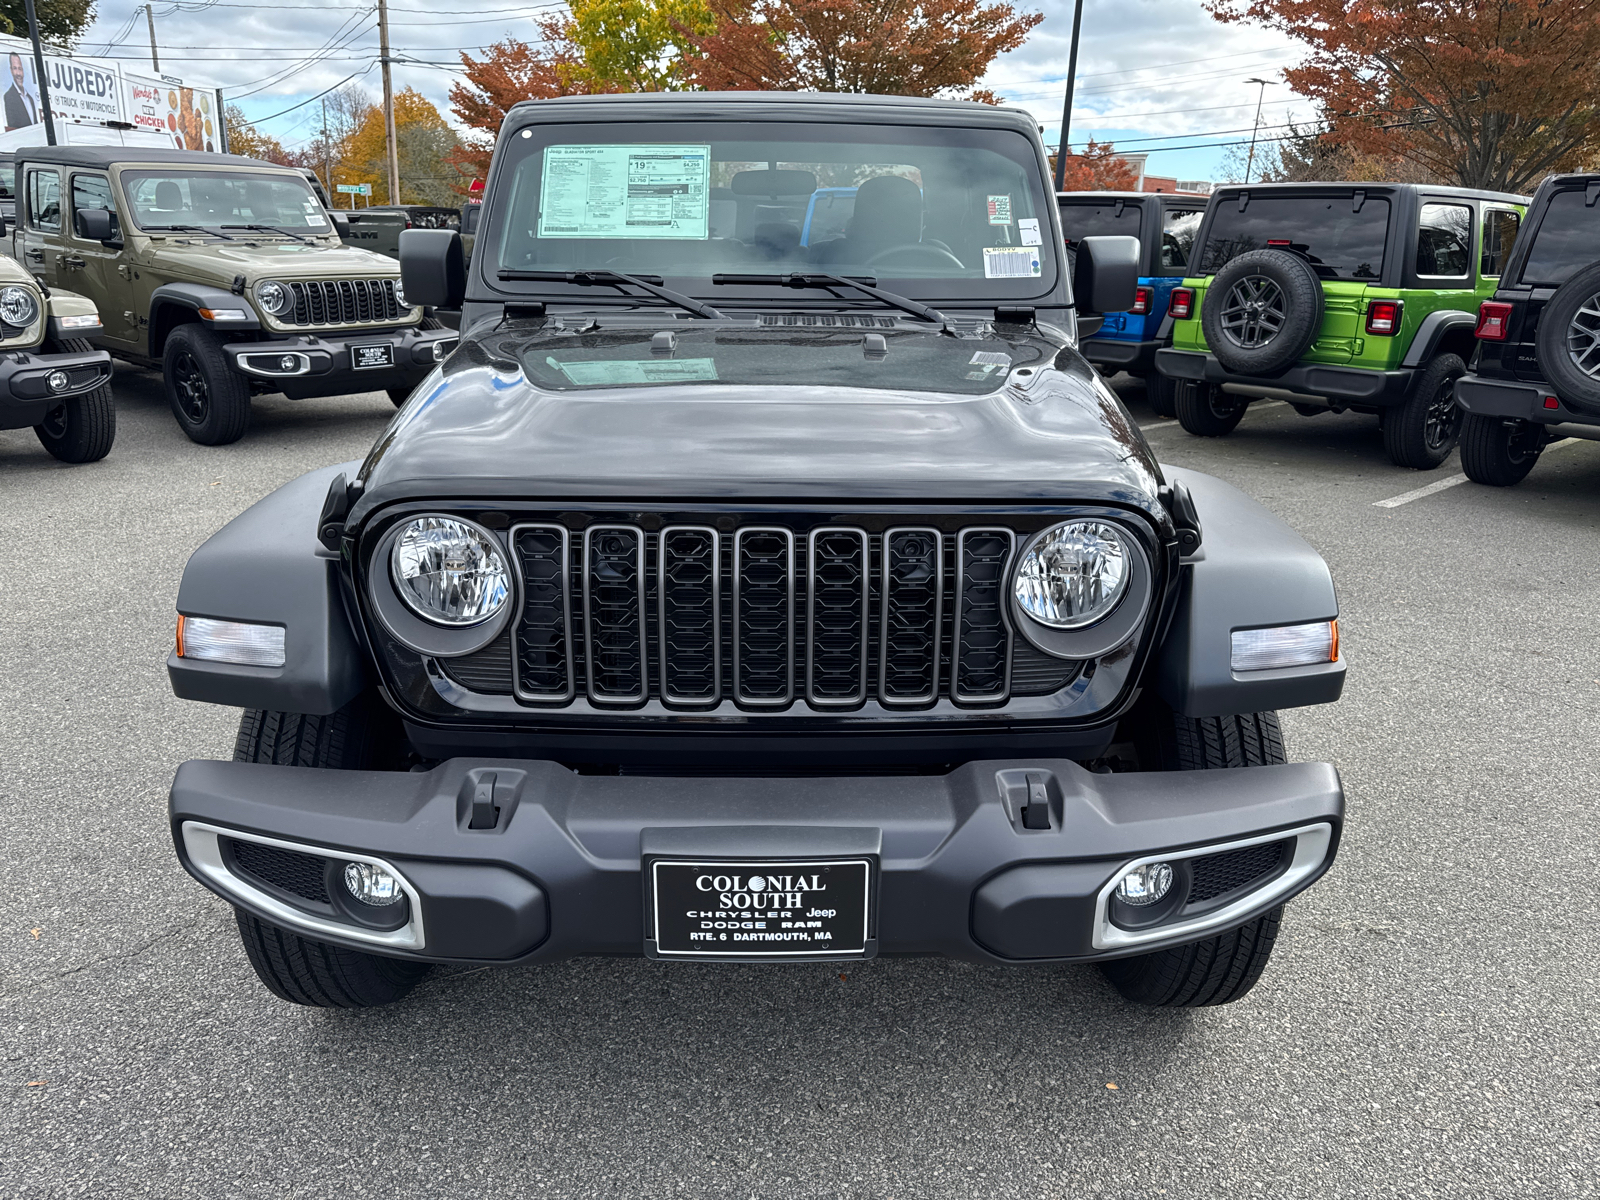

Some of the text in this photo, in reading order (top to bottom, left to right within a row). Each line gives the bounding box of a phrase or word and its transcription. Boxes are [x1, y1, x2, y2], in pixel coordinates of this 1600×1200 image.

[60, 96, 78, 108] TRUCK
[86, 101, 116, 114] MOTORCYCLE
[134, 114, 165, 128] CHICKEN
[634, 161, 645, 169] 19
[349, 231, 378, 239] AM
[696, 875, 826, 892] COLONIAL
[719, 892, 803, 909] SOUTH
[806, 908, 836, 918] Jeep
[701, 921, 766, 929] DODGE
[690, 932, 832, 942] RTE. 6 DARTMOUTH, MA
